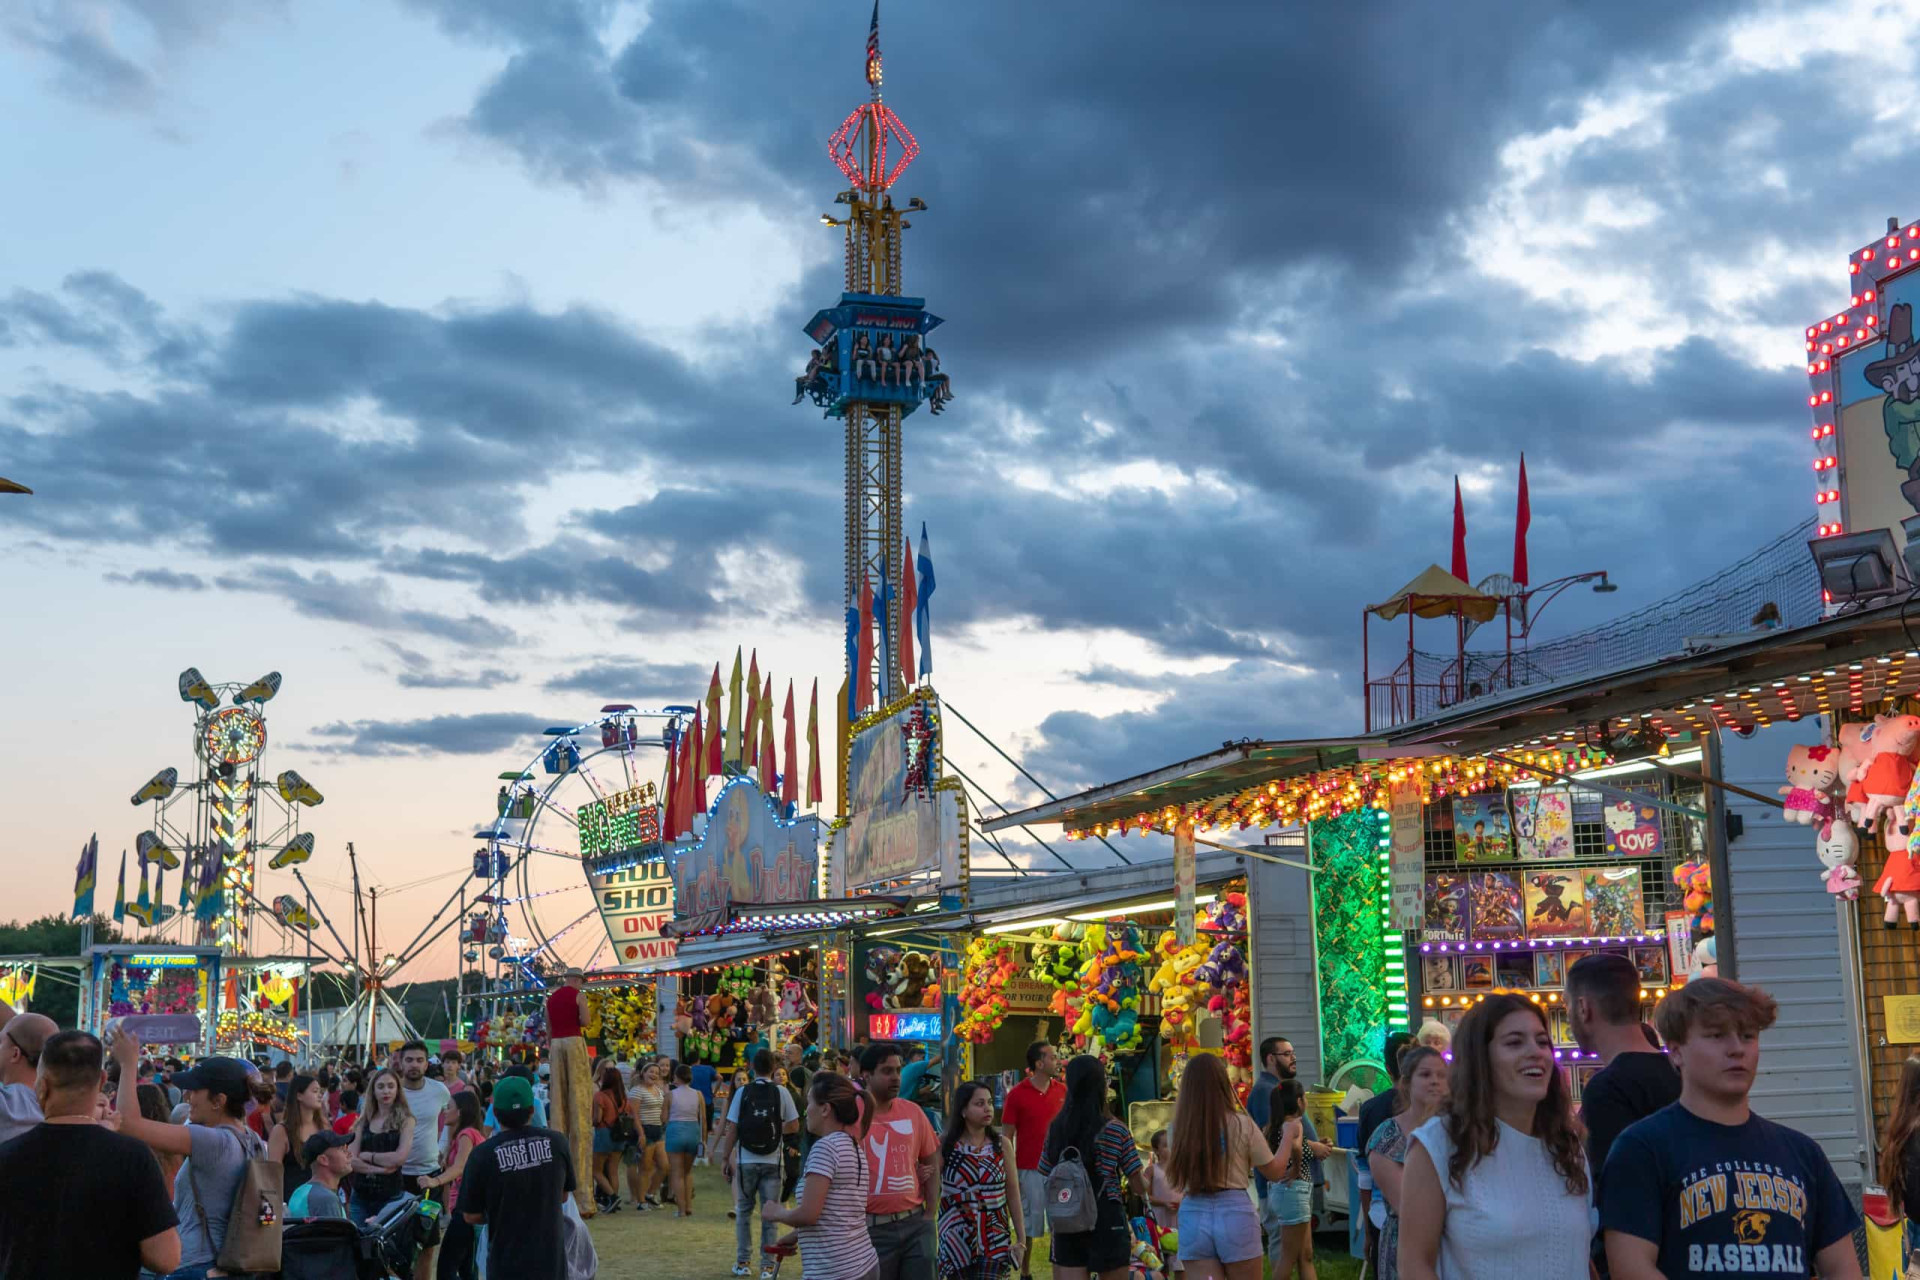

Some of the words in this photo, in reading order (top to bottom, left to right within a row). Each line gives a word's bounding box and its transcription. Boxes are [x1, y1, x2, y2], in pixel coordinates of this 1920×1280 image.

[856, 312, 888, 327] SUPER
[889, 316, 918, 329] SHOT
[577, 803, 610, 857] BIG
[610, 804, 659, 853] PRIZES
[1620, 832, 1656, 851] LOVE
[603, 887, 673, 911] SHO
[1424, 929, 1465, 941] FORTNITE
[130, 957, 152, 965] LET'S
[153, 957, 166, 965] GO
[166, 957, 198, 965] FISHING
[145, 1026, 176, 1038] EXIT
[494, 1144, 528, 1169] DYSE
[528, 1139, 552, 1160] ONE
[1682, 1168, 1707, 1187] THE
[1716, 1160, 1783, 1176] COLLEGE
[1680, 1173, 1728, 1230] NEW
[1688, 1243, 1805, 1274] BASEBALL
